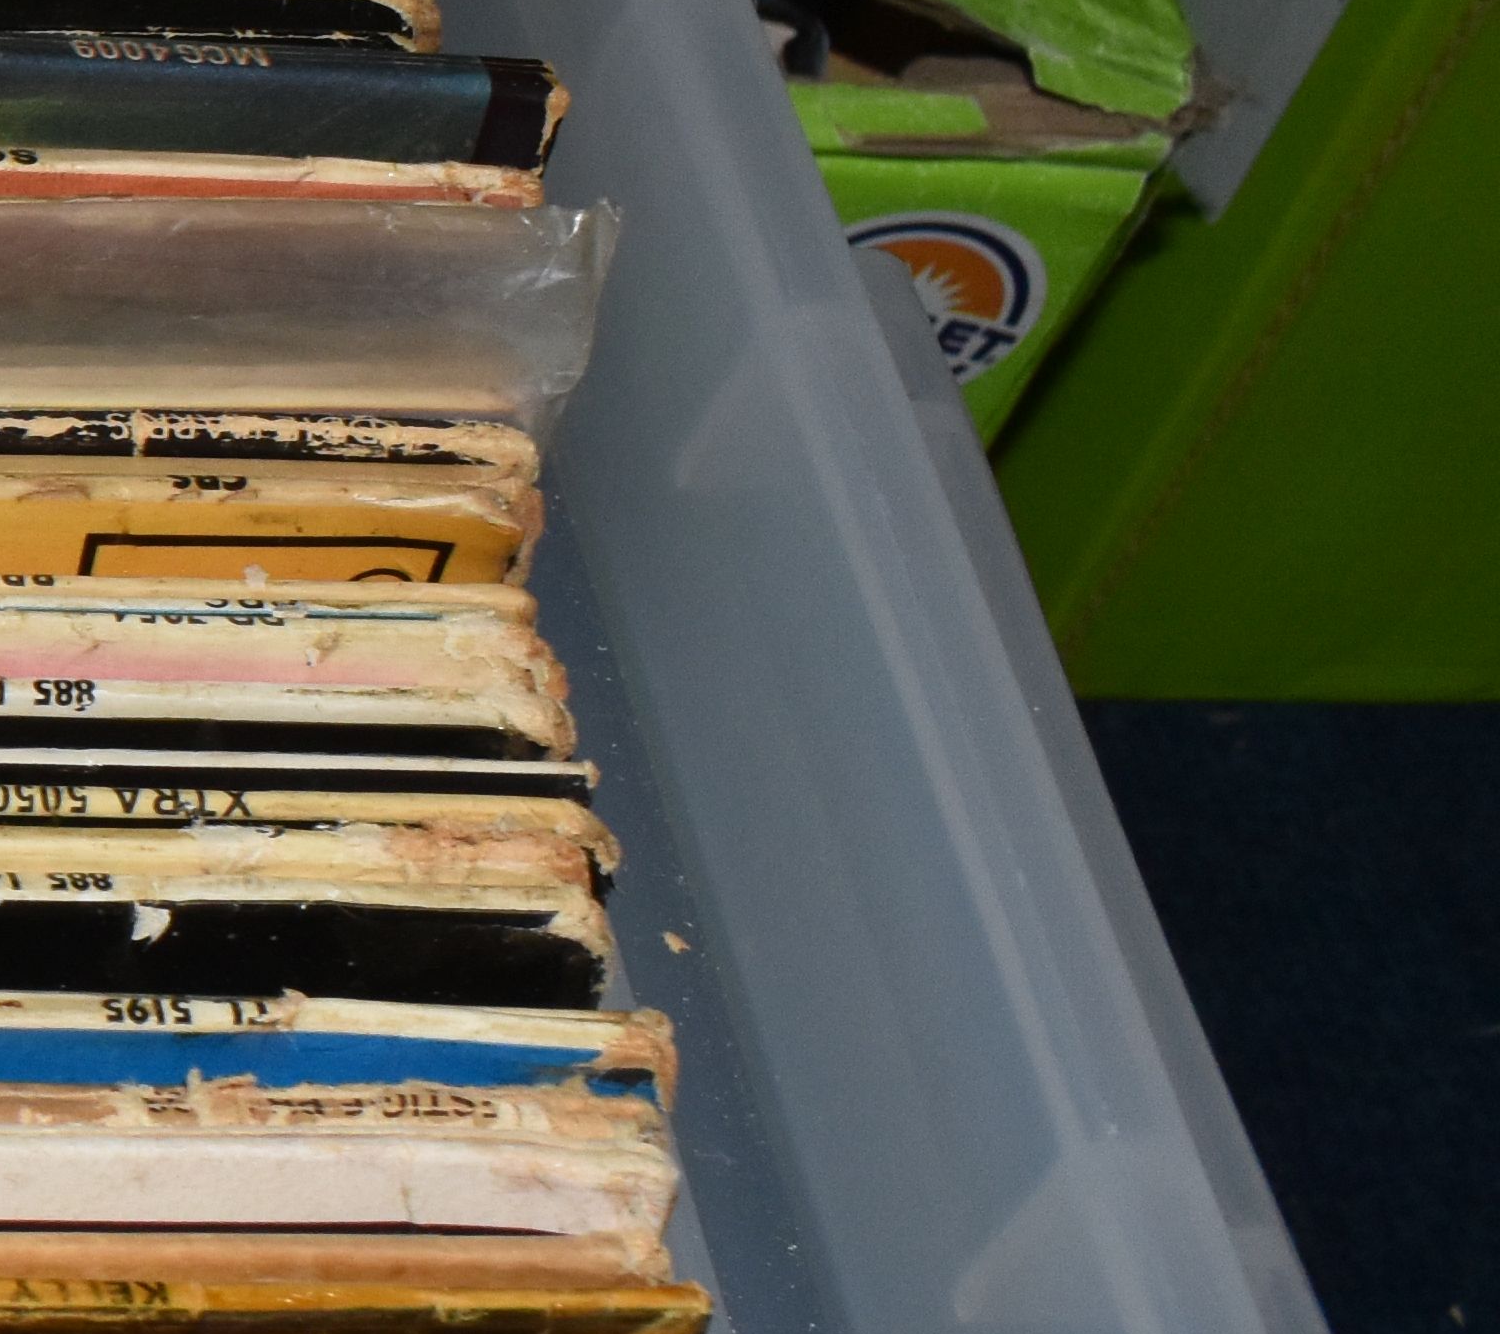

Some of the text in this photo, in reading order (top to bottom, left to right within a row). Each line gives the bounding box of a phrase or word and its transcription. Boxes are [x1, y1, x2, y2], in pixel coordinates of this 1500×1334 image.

[73, 39, 271, 68] MCG 4009
[34, 678, 97, 712] 885
[102, 999, 193, 1025] 5195
[5, 1278, 175, 1308] KELLY
